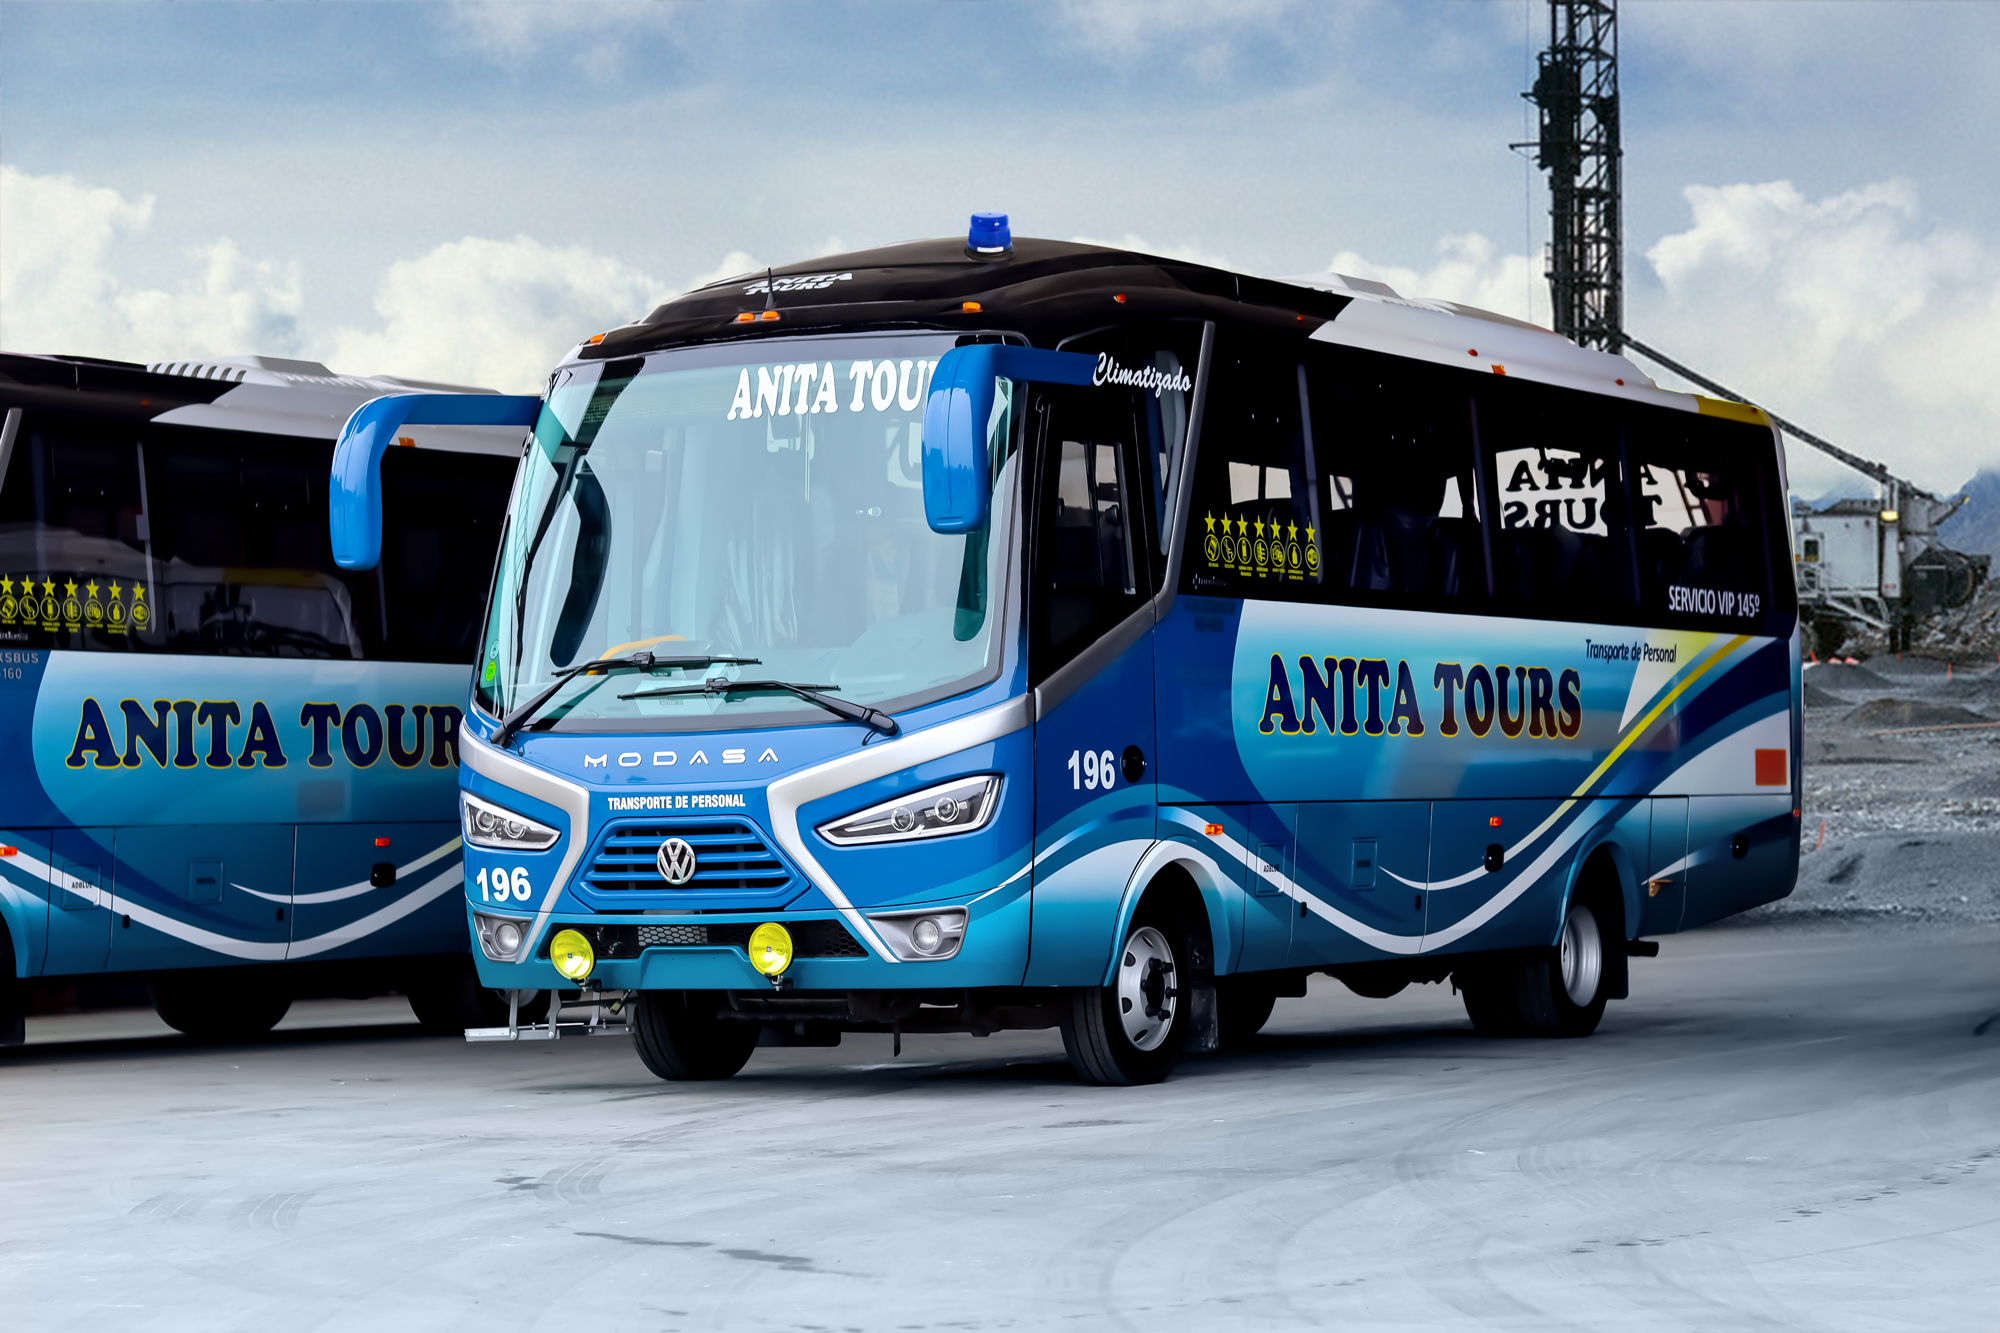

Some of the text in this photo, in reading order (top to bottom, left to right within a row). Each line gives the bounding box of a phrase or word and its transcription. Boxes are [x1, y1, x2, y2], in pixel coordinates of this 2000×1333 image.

[743, 273, 853, 290] ANITA
[745, 281, 834, 295] TOURS
[727, 359, 939, 420] ANITA TOU
[1092, 351, 1192, 398] Climatizado
[1668, 585, 1716, 614] SERVICIO
[1718, 590, 1735, 616] VIP
[1586, 639, 1677, 664] Transporte de Personal
[1258, 652, 1583, 739] ANITA TOURS
[65, 697, 288, 769] ANITA
[584, 747, 779, 768] MODASA
[1067, 749, 1116, 790] 196
[608, 793, 746, 810] TRANSPORTE DE PERSONAL
[475, 867, 532, 902] 196
